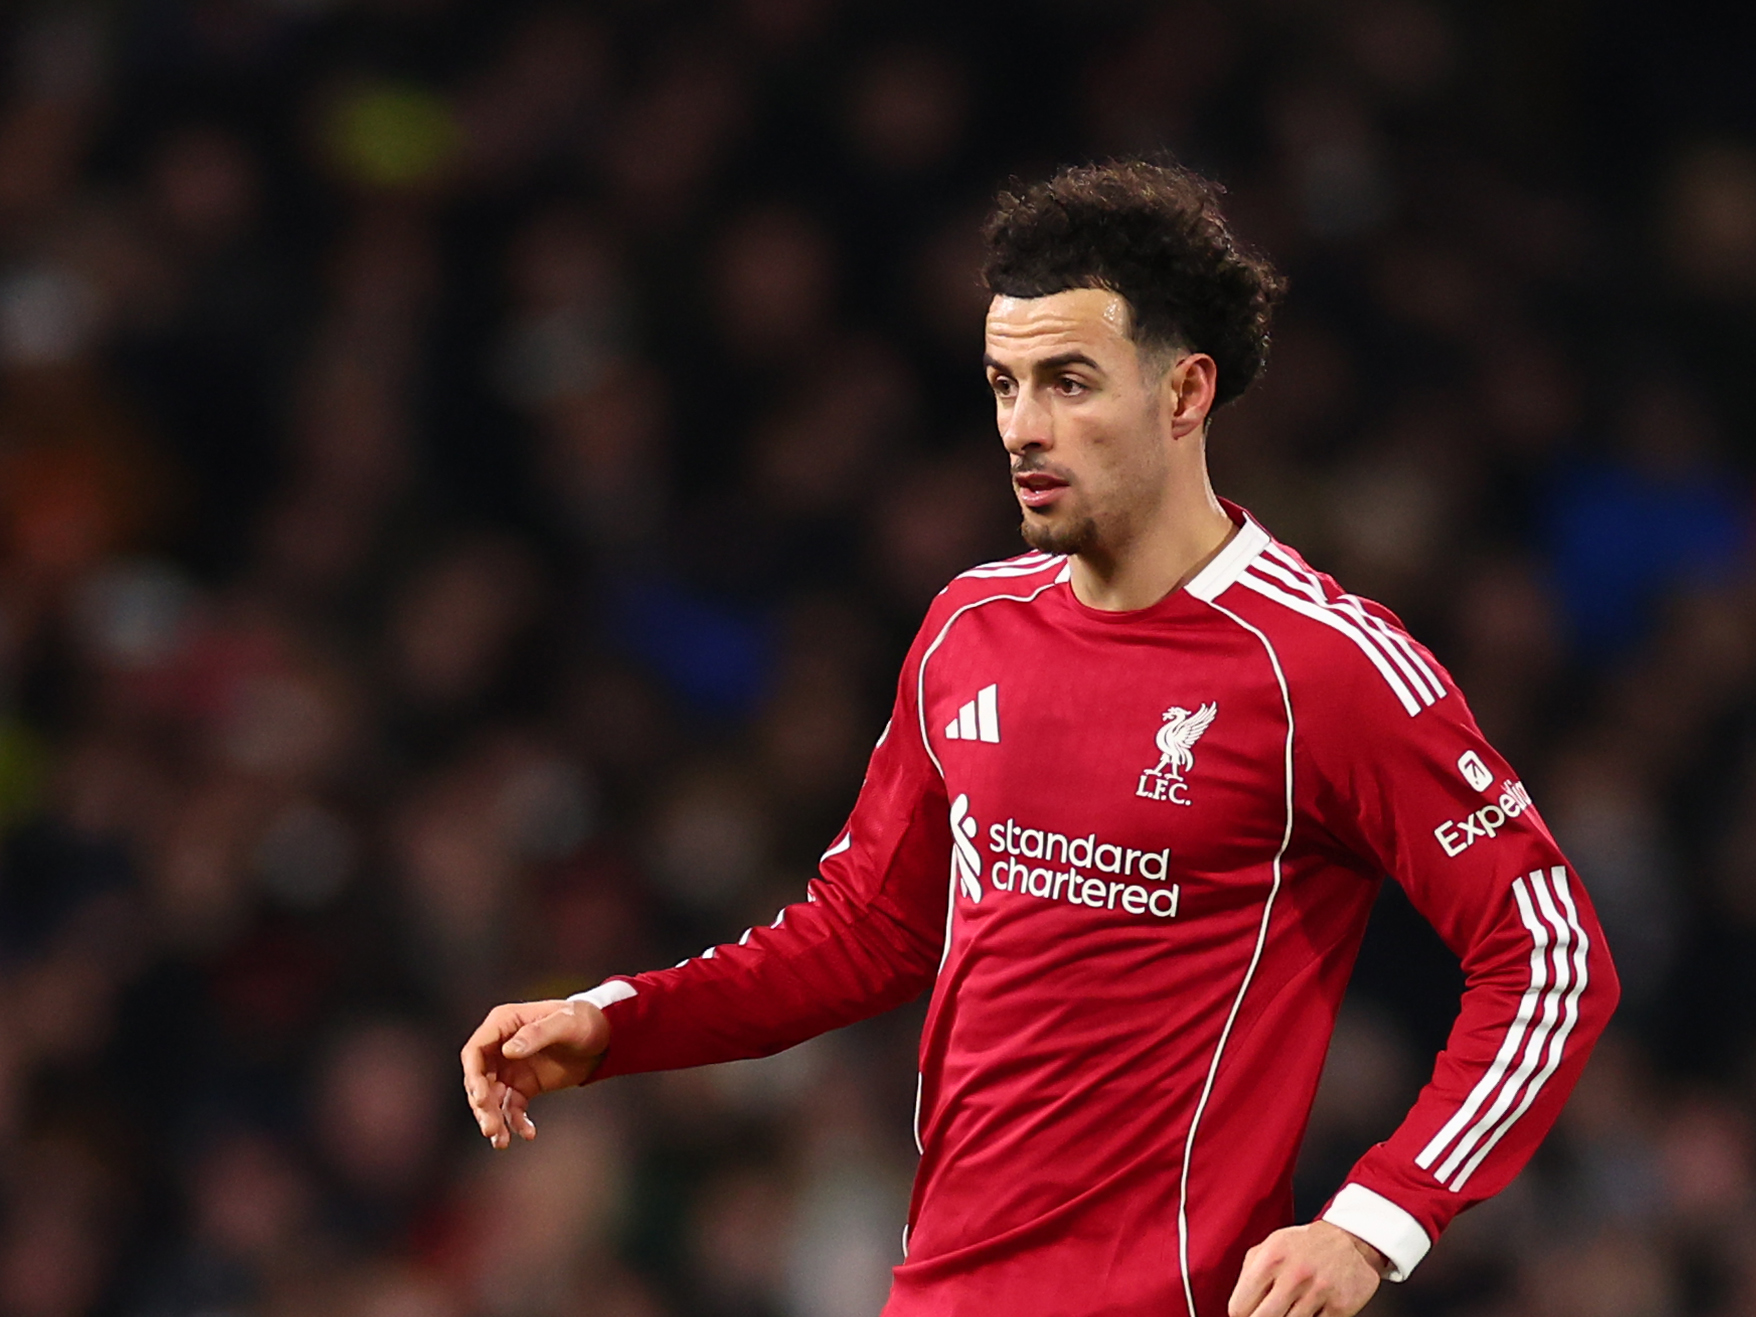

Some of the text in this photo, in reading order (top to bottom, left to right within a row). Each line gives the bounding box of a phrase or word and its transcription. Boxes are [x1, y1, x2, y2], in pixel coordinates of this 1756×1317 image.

[1135, 774, 1192, 806] L.F.C.
[989, 818, 1170, 881] standard
[991, 856, 1180, 918] chartered
